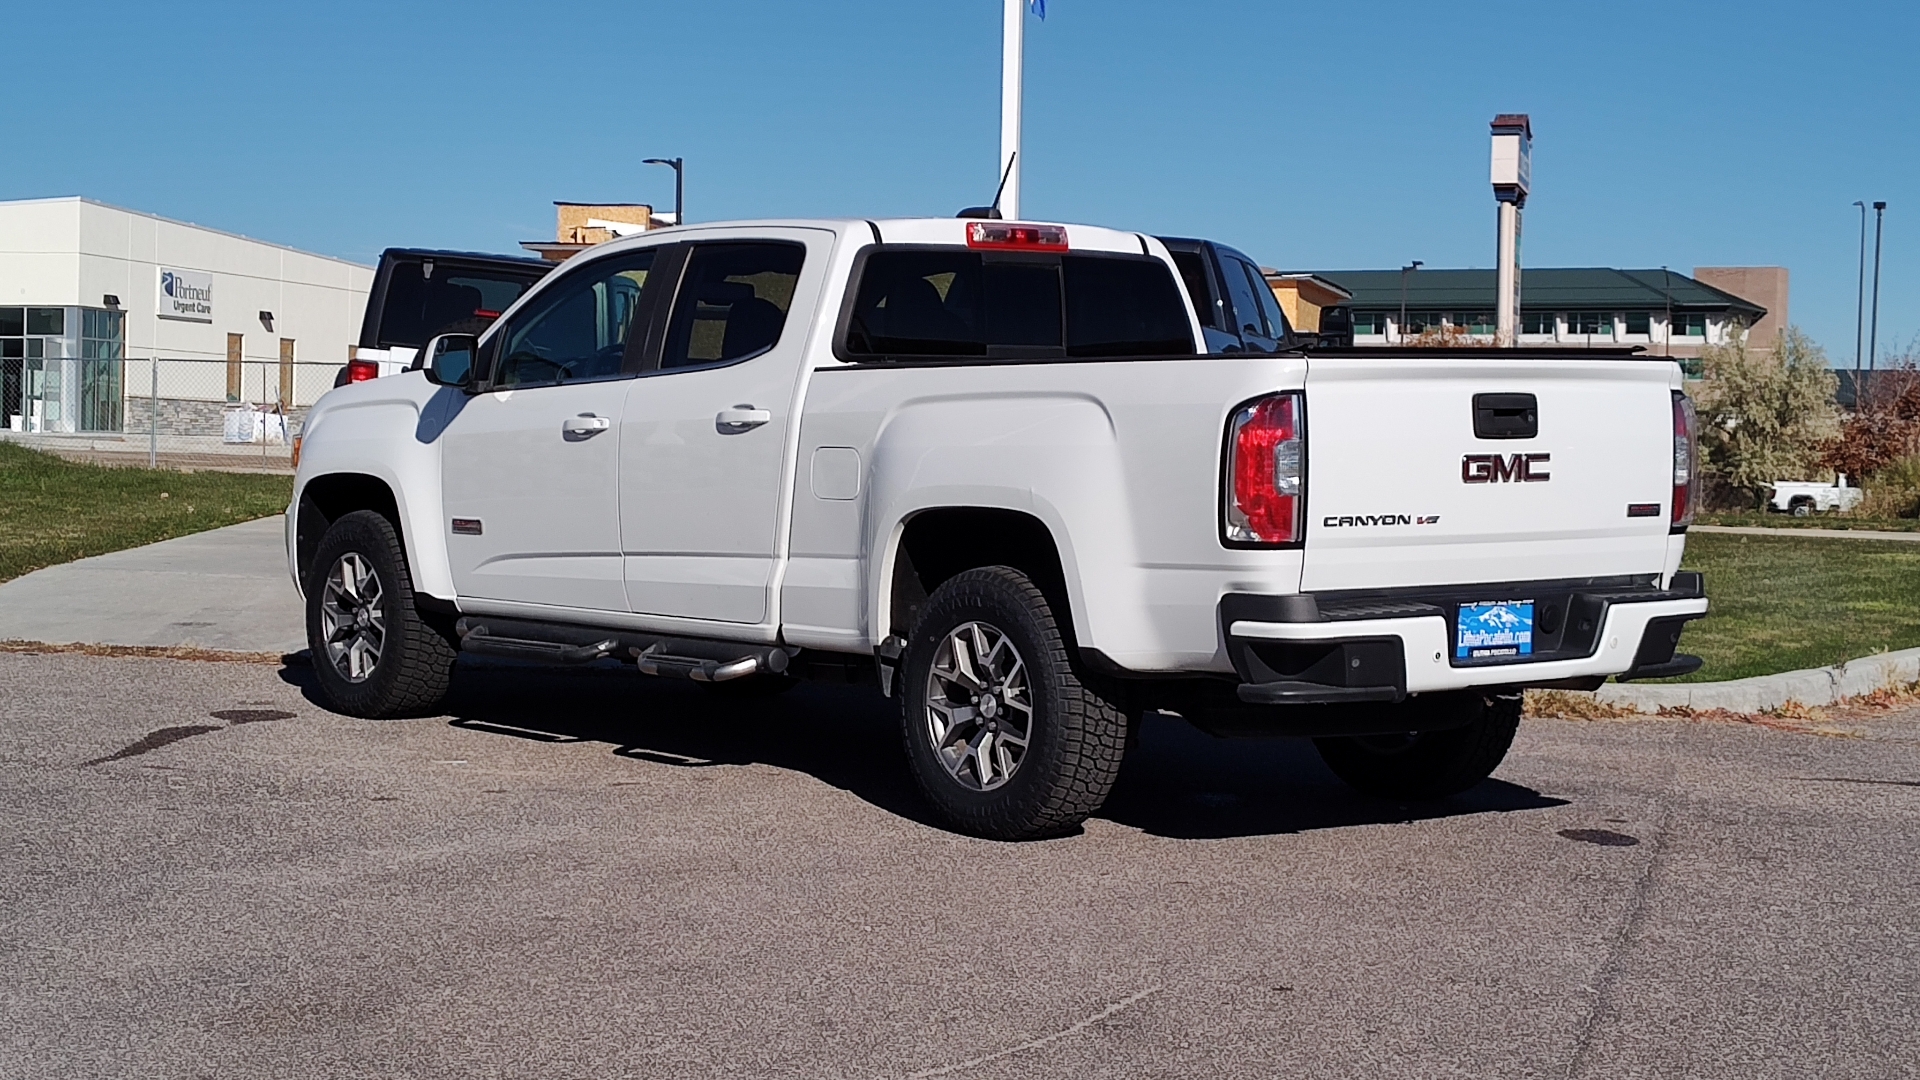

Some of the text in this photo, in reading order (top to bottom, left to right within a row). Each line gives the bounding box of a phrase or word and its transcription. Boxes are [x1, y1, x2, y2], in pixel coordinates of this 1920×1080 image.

[174, 276, 212, 301] Portneuf
[173, 300, 211, 314] Urgent Care
[1462, 453, 1550, 483] GMC
[1323, 514, 1411, 527] CANYON
